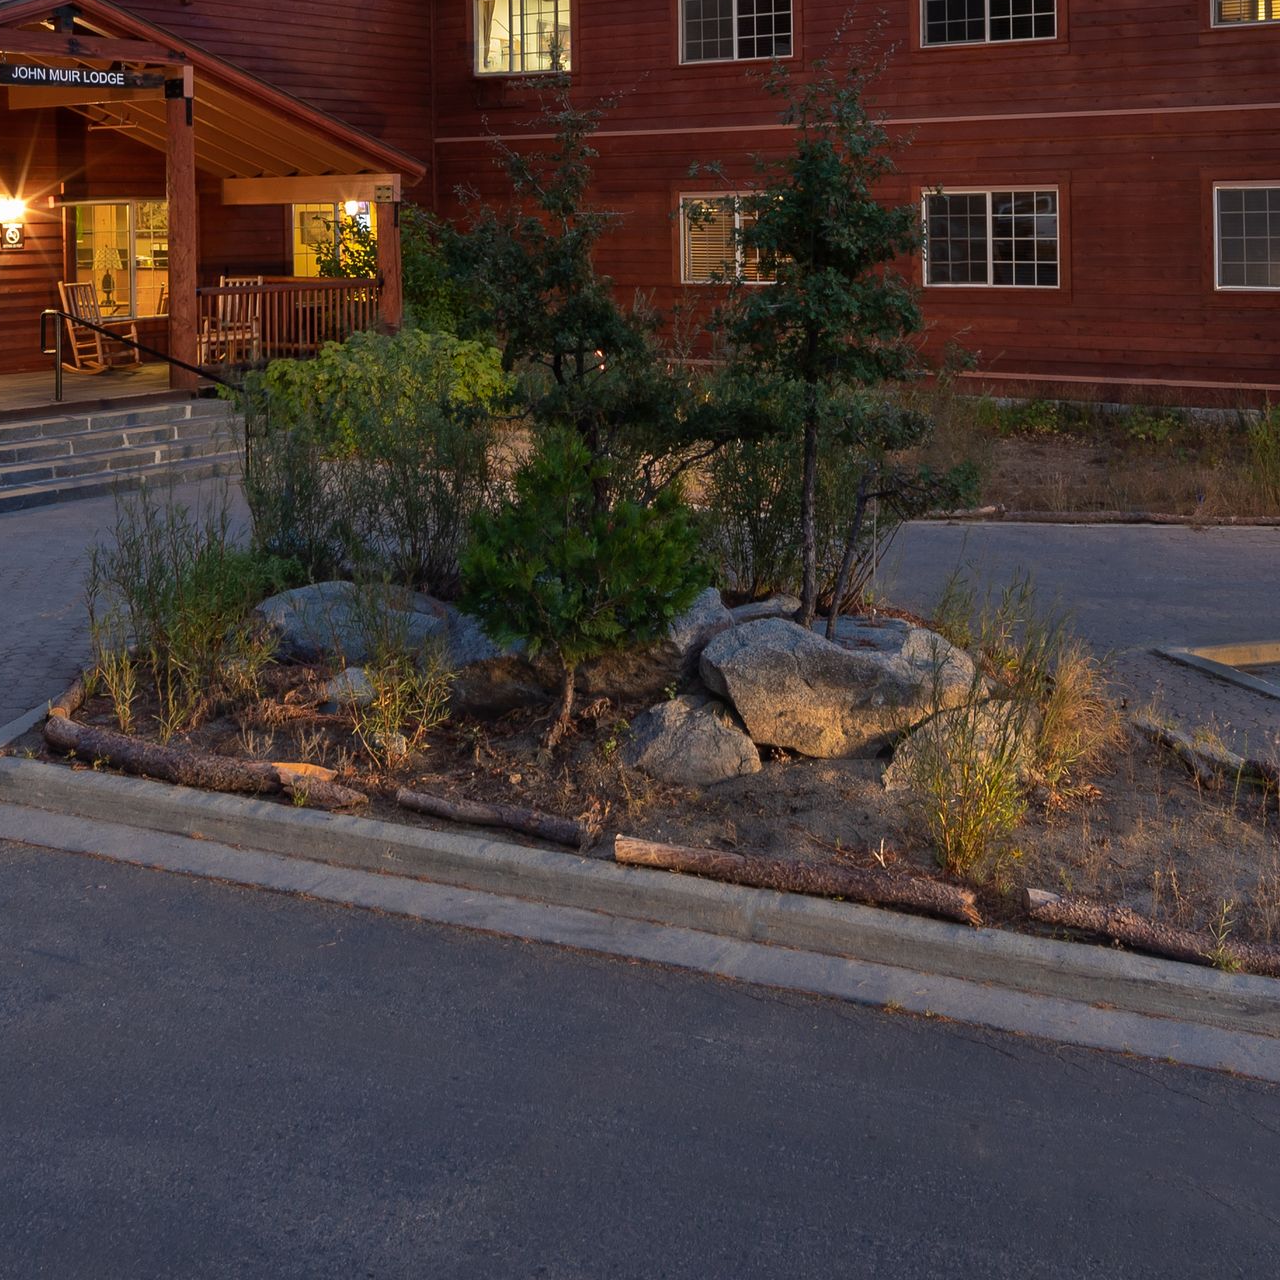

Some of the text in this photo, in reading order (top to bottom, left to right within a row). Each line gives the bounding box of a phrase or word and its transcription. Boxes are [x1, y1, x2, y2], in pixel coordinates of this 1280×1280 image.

[11, 66, 125, 85] JOHN MUIR LODGE
